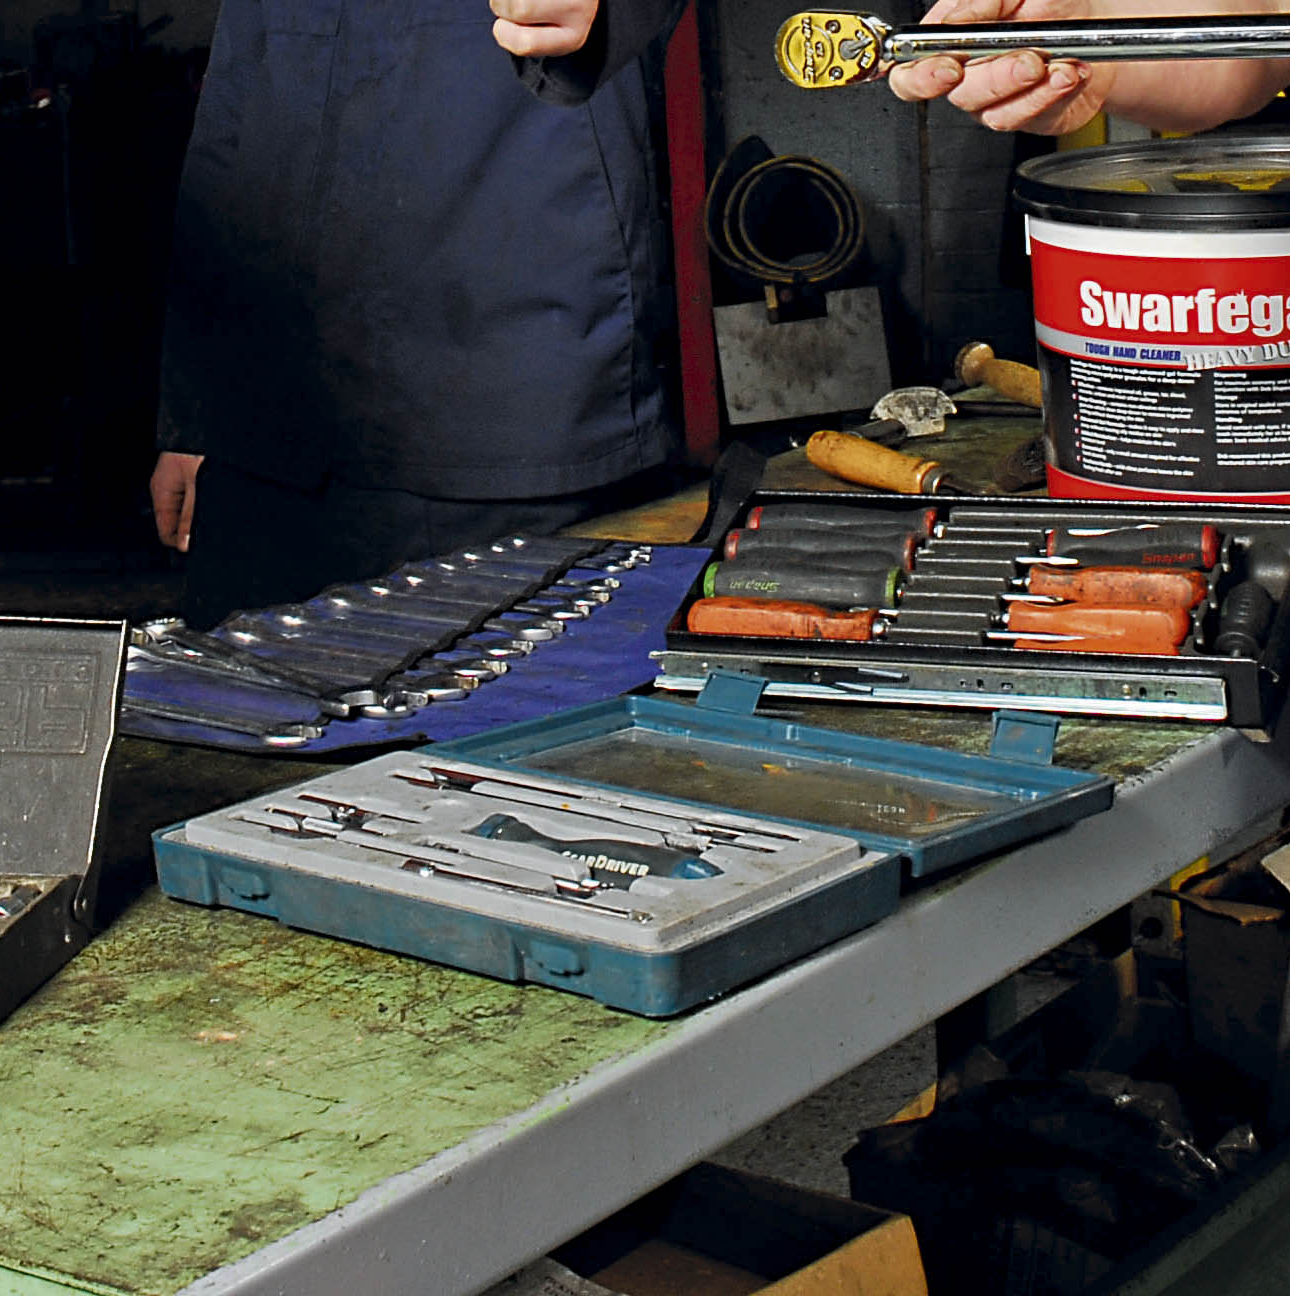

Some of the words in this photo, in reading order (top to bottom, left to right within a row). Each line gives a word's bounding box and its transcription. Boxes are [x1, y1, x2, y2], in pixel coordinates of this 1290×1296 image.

[1085, 341, 1110, 356] TOUGH
[1112, 346, 1137, 359] HAND
[1140, 348, 1181, 362] CLEANER
[1183, 346, 1258, 371] HEAVY
